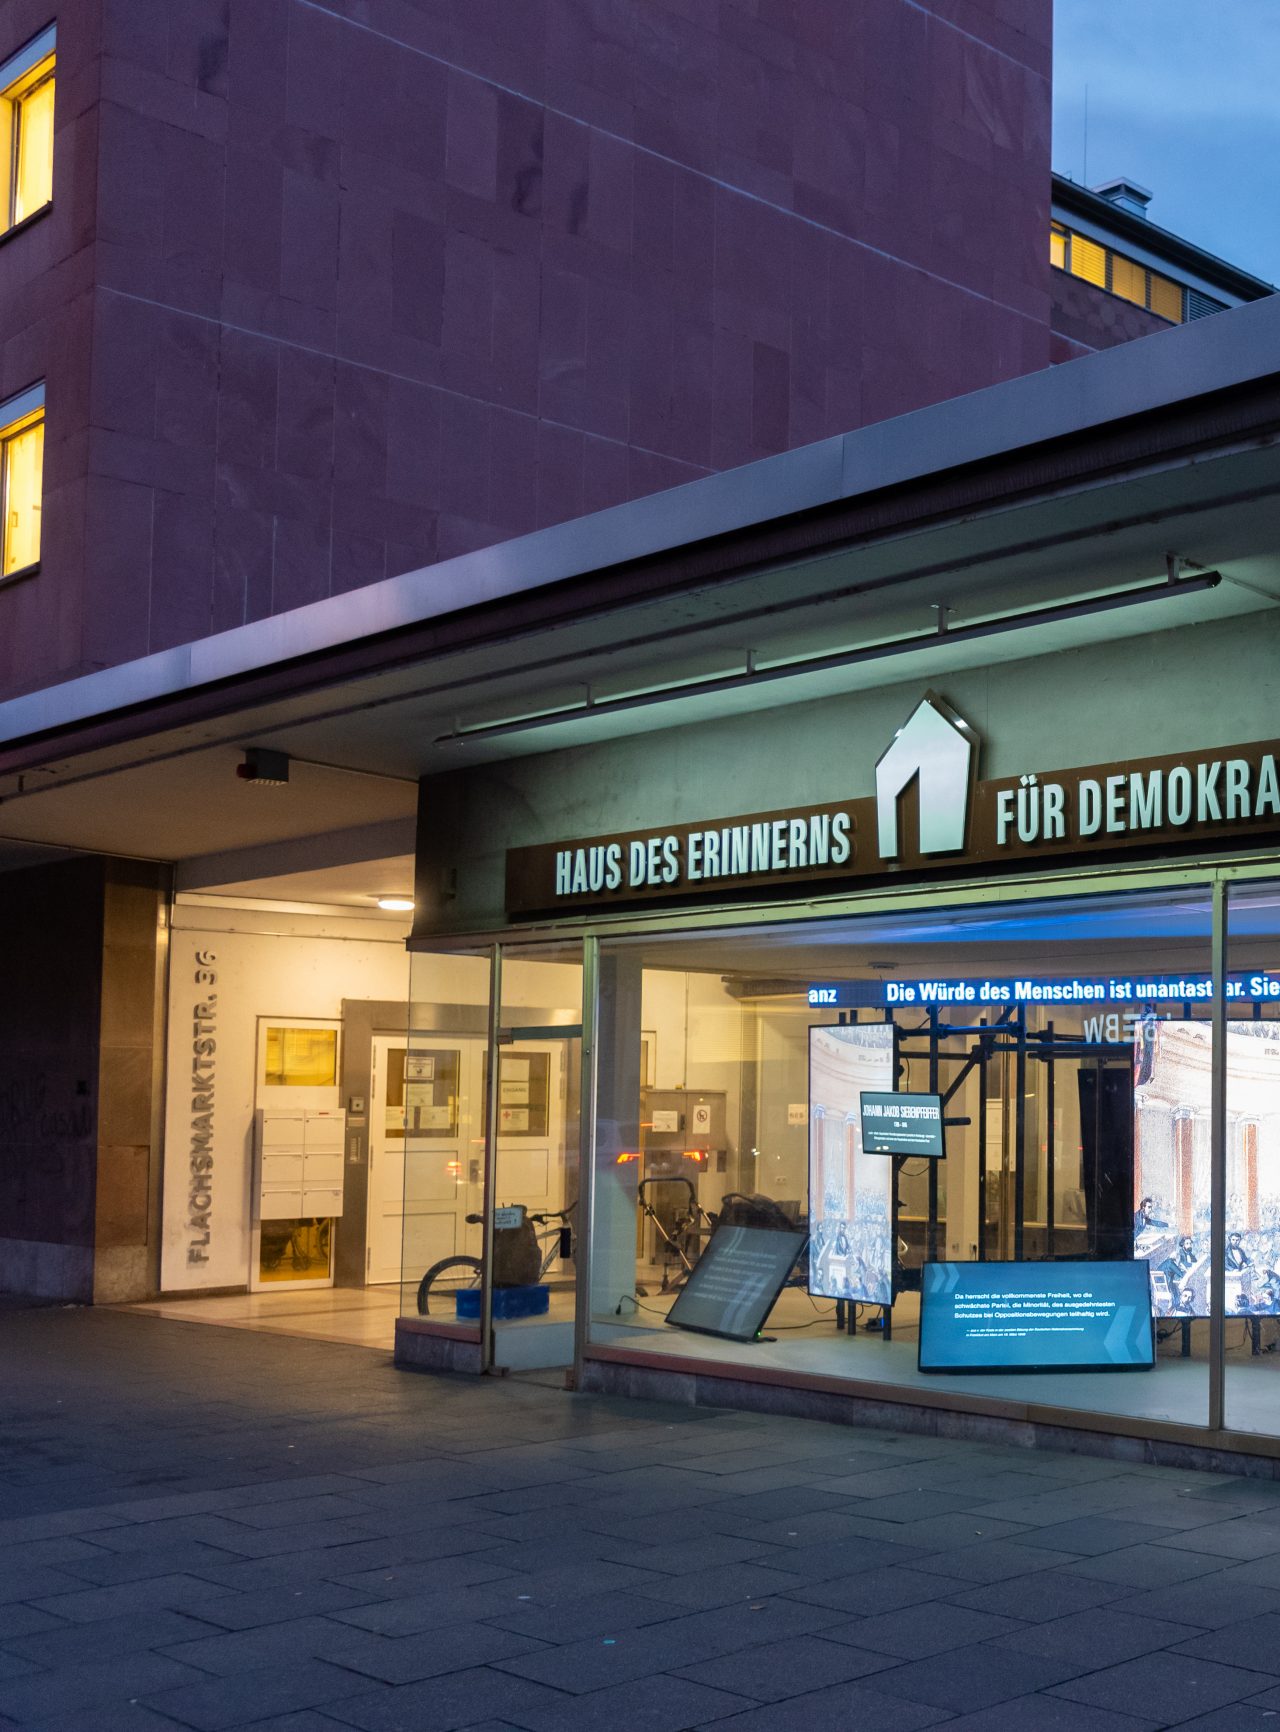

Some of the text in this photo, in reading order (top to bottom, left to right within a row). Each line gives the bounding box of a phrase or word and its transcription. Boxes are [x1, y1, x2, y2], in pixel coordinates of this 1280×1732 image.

[555, 843, 622, 895] HAUS
[629, 836, 680, 887] DES
[687, 813, 851, 881] ERINNERNS
[997, 774, 1065, 845] FÜR
[808, 989, 837, 1003] anz
[886, 983, 915, 1002] Die
[918, 982, 976, 1001] Würde
[979, 982, 1010, 1000] des
[1015, 981, 1105, 1000] Menschen
[1109, 980, 1131, 998] ist
[1136, 979, 1245, 998] unantastar.
[1250, 978, 1280, 996] Sie
[187, 950, 218, 1267] FLACHSMARKTSTR. 36
